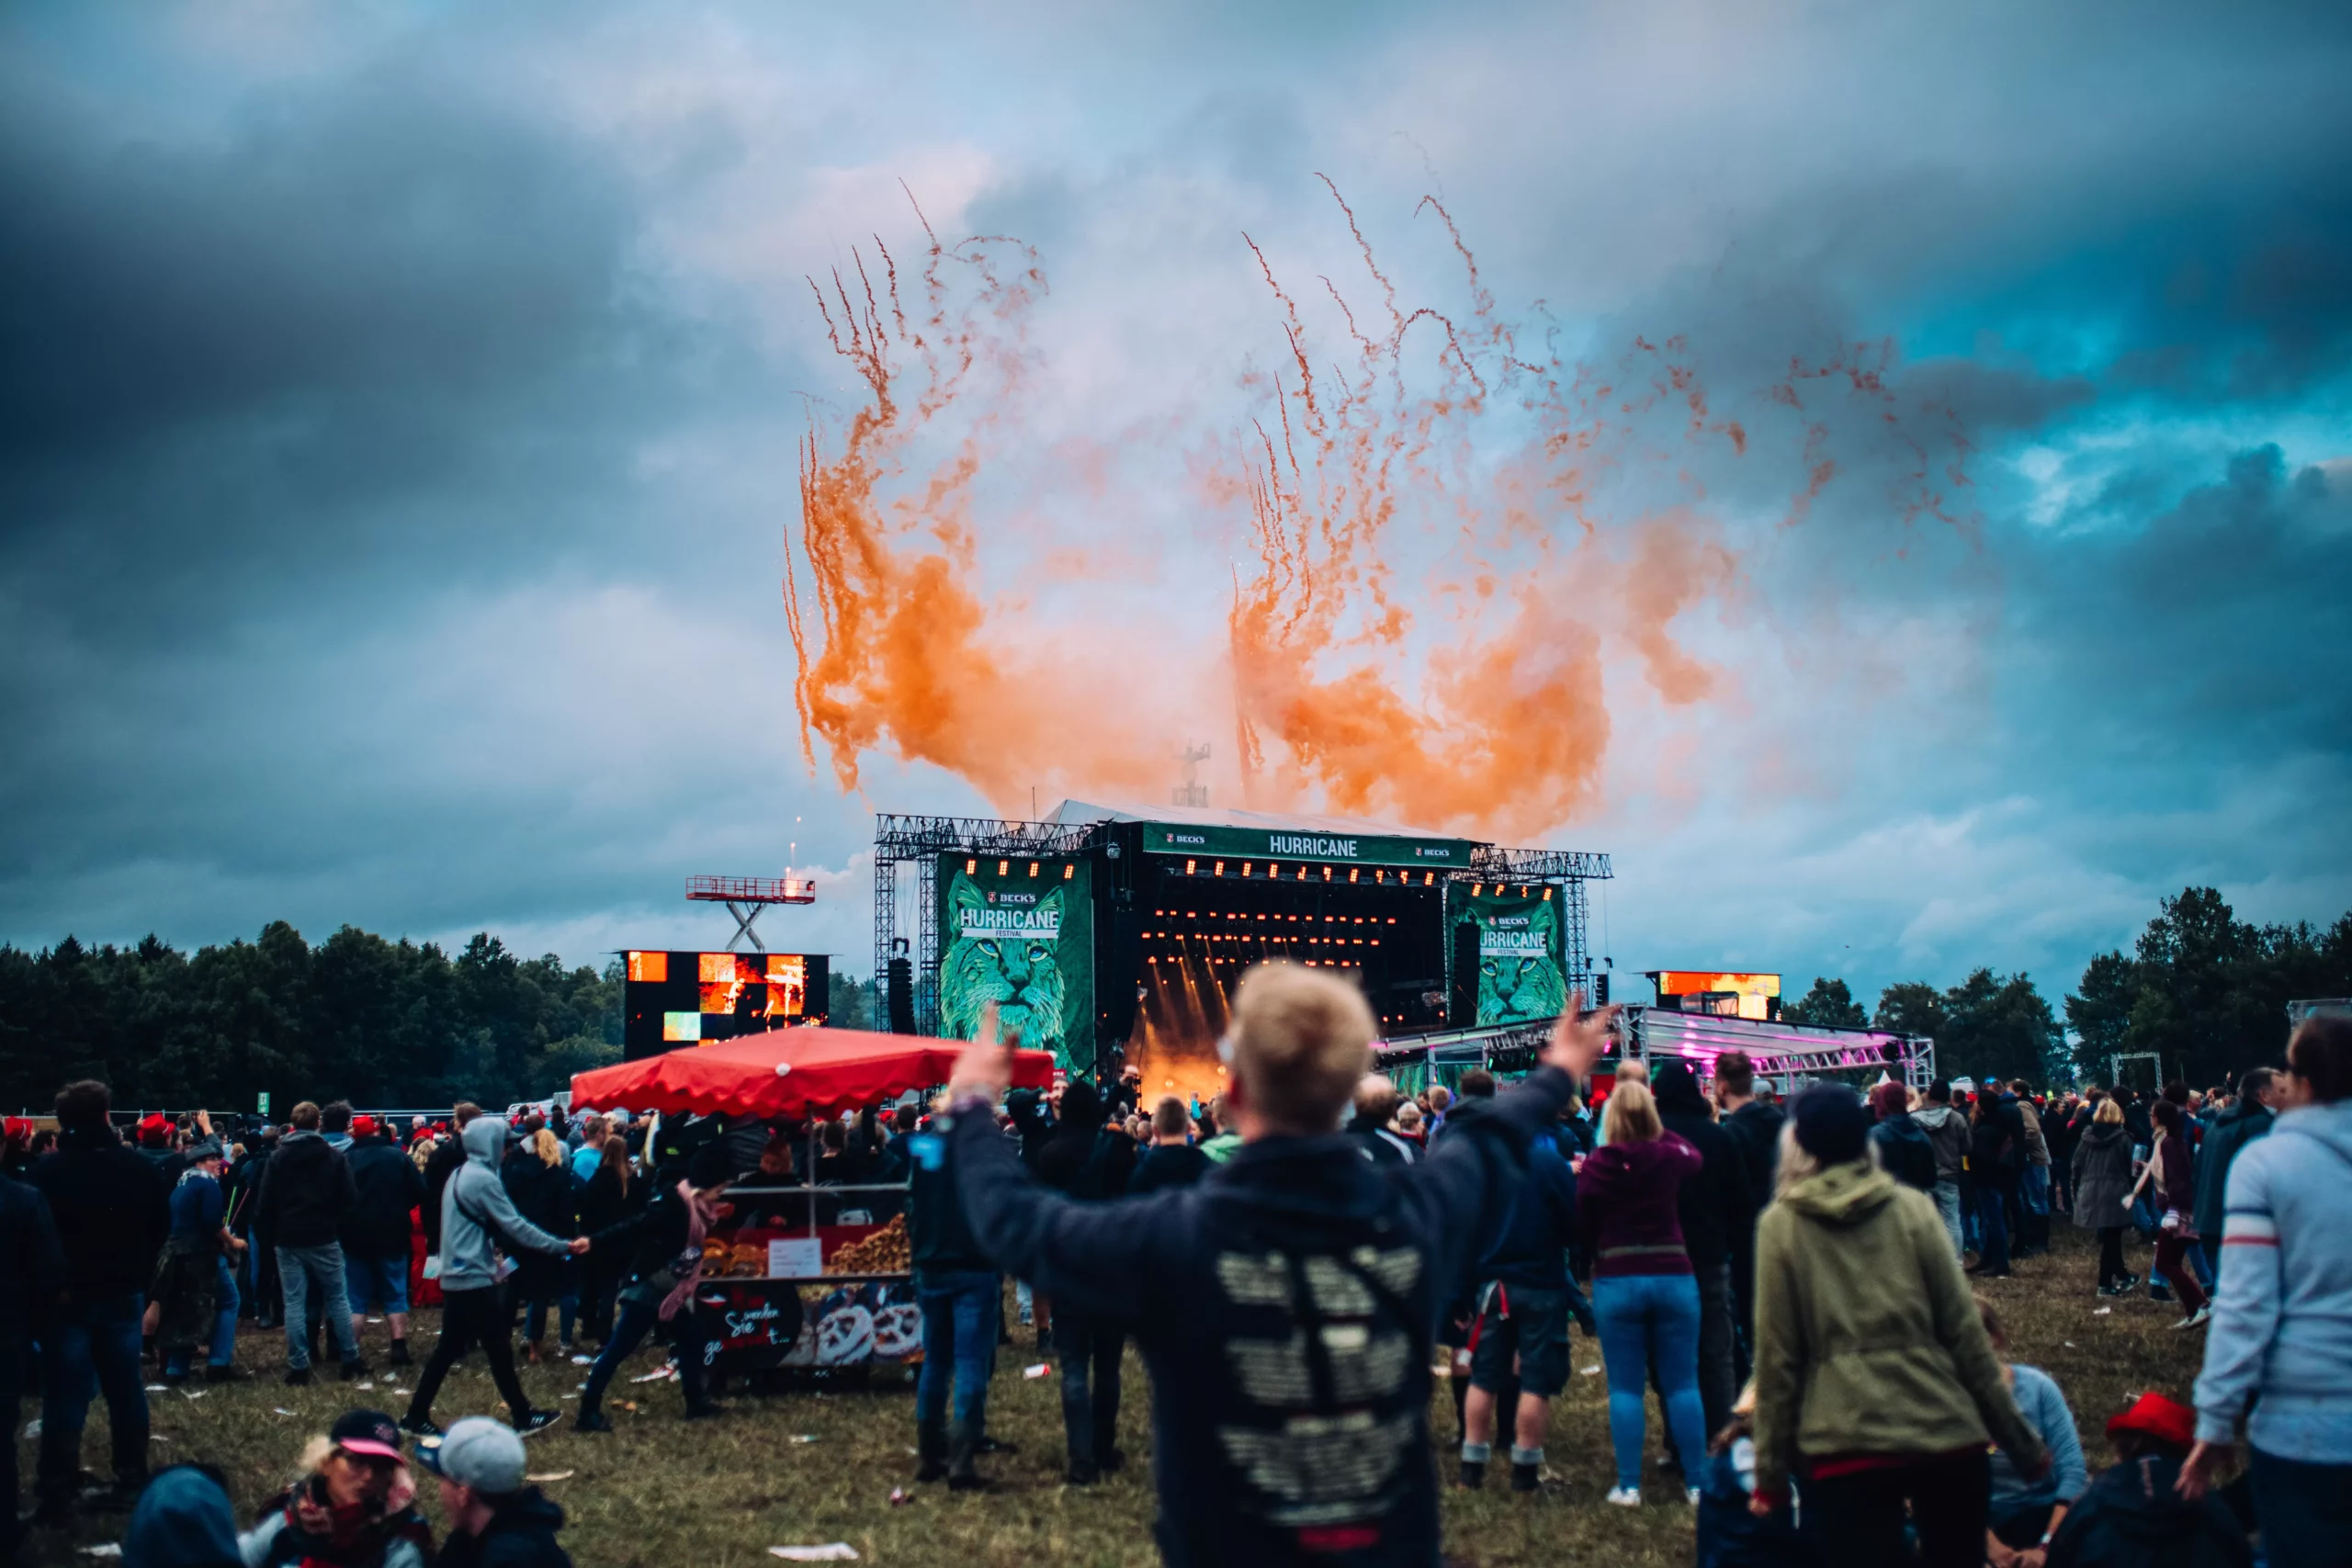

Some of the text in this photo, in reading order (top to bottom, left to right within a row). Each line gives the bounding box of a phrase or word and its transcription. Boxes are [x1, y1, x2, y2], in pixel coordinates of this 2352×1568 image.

[1176, 835, 1205, 843] BECK'S
[1270, 835, 1358, 857] HURRICANE
[1424, 849, 1450, 857] BECK'S
[1000, 894, 1036, 903] BECK'S
[960, 908, 1059, 929] HURRICANE
[1480, 931, 1546, 948] URRICANE
[725, 1310, 755, 1337] Sie
